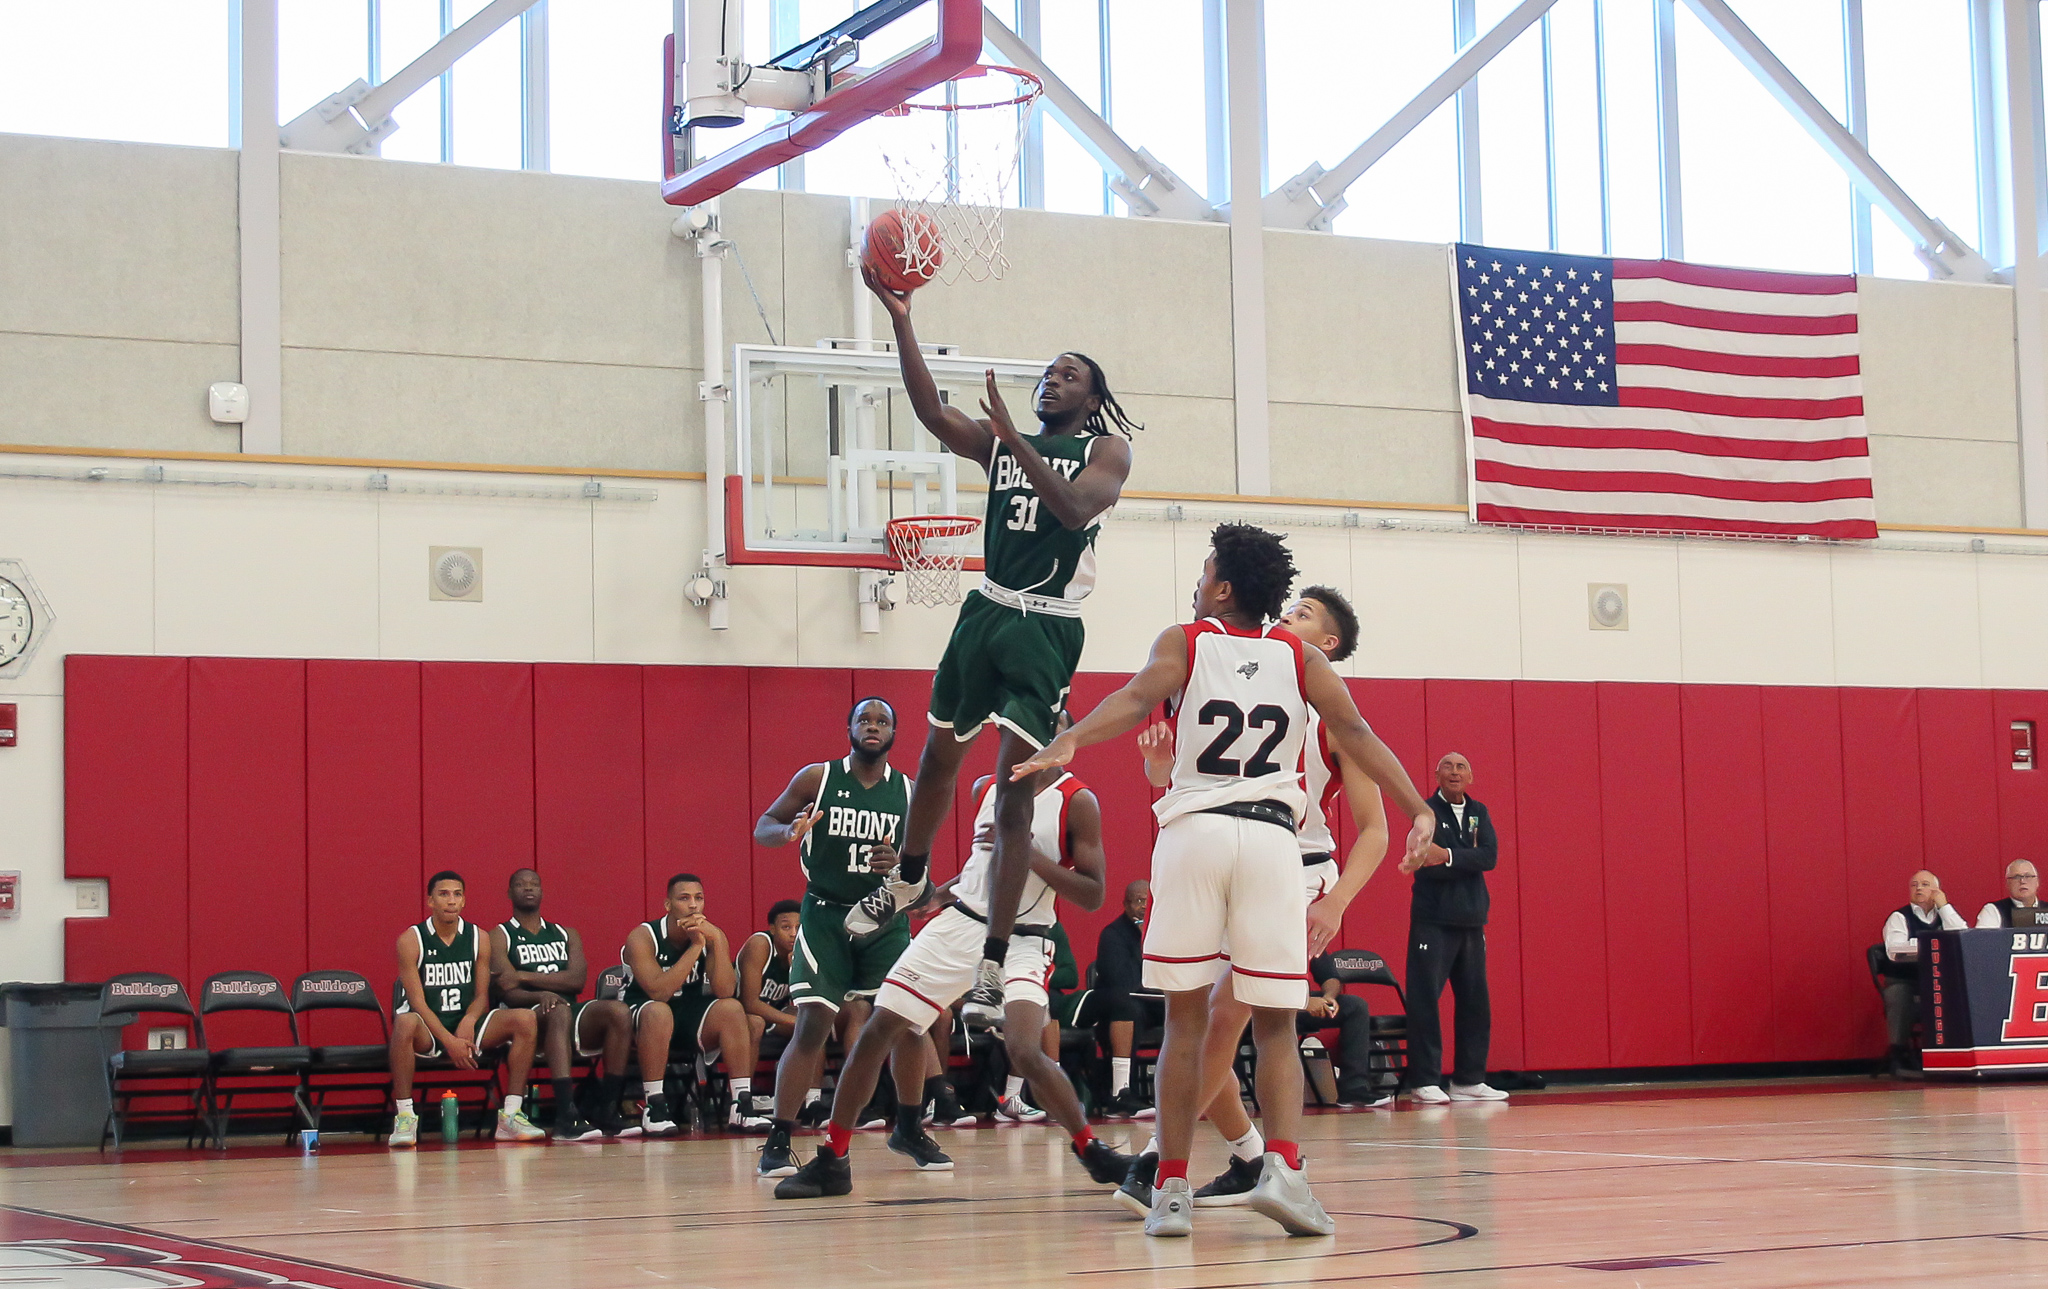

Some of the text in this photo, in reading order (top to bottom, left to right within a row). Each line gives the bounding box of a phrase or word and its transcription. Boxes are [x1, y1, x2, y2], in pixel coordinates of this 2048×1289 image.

[1007, 495, 1040, 532] 31
[17, 616, 23, 627] 3
[11, 633, 17, 643] 4
[1196, 699, 1290, 778] 22
[828, 806, 900, 843] BRONX
[847, 843, 874, 873] 13
[517, 941, 568, 965] BRONX
[2011, 933, 2048, 951] BU
[424, 960, 473, 987] BRONX
[1334, 957, 1384, 971] Bulldogs
[111, 982, 179, 998] Bulldogs
[211, 980, 278, 997] Bulldogs
[301, 979, 366, 996] Bulldogs
[440, 987, 462, 1012] 12
[1931, 938, 1944, 1045] BULLDOGS
